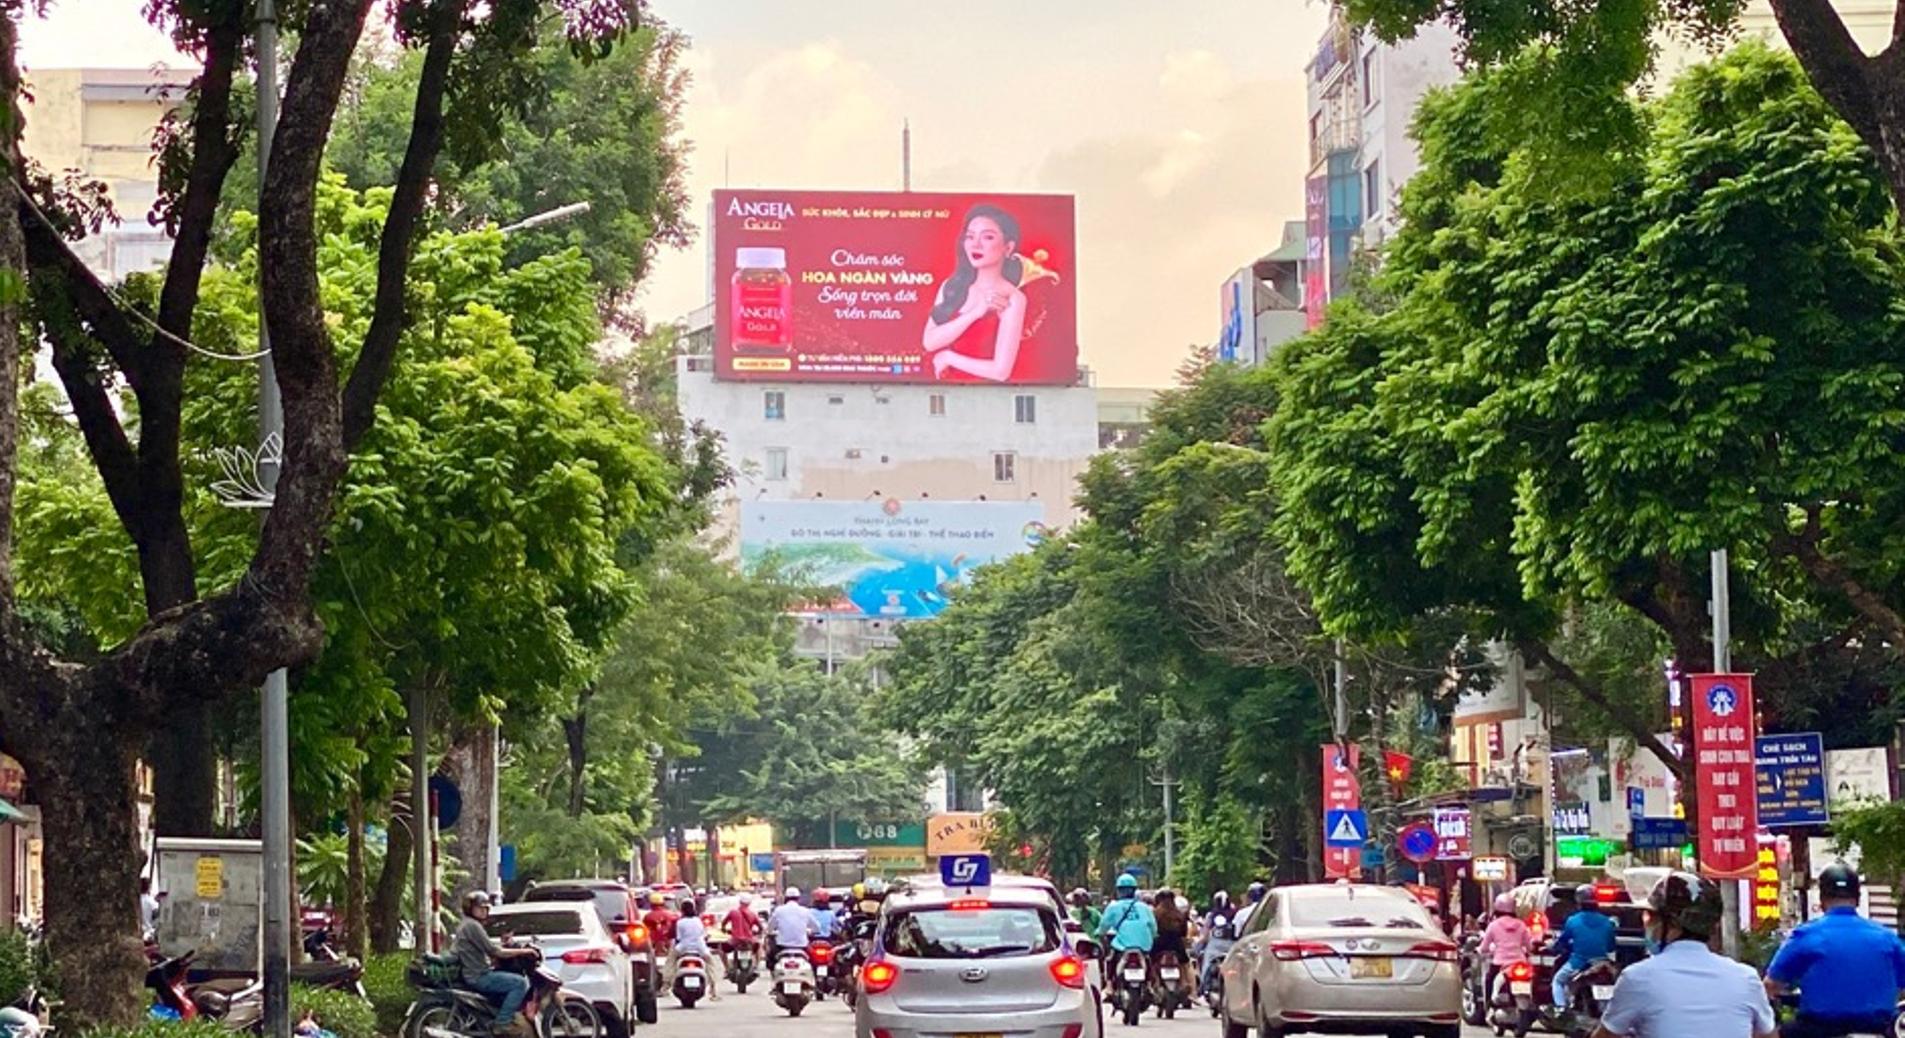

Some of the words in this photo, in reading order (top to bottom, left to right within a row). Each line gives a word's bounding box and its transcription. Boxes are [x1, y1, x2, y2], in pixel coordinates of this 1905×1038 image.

[727, 197, 795, 220] ANGELA
[744, 217, 782, 230] GOLD
[831, 249, 879, 267] Chăm
[881, 253, 904, 267] sóc
[802, 271, 836, 283] HOA
[840, 269, 886, 284] NGÀN
[890, 269, 934, 285] VÀNG
[818, 286, 858, 306] Sống
[861, 289, 892, 304] trọn
[894, 288, 918, 302] đời
[834, 306, 867, 319] viên
[869, 307, 903, 319] mãn
[1718, 750, 1734, 764] CON
